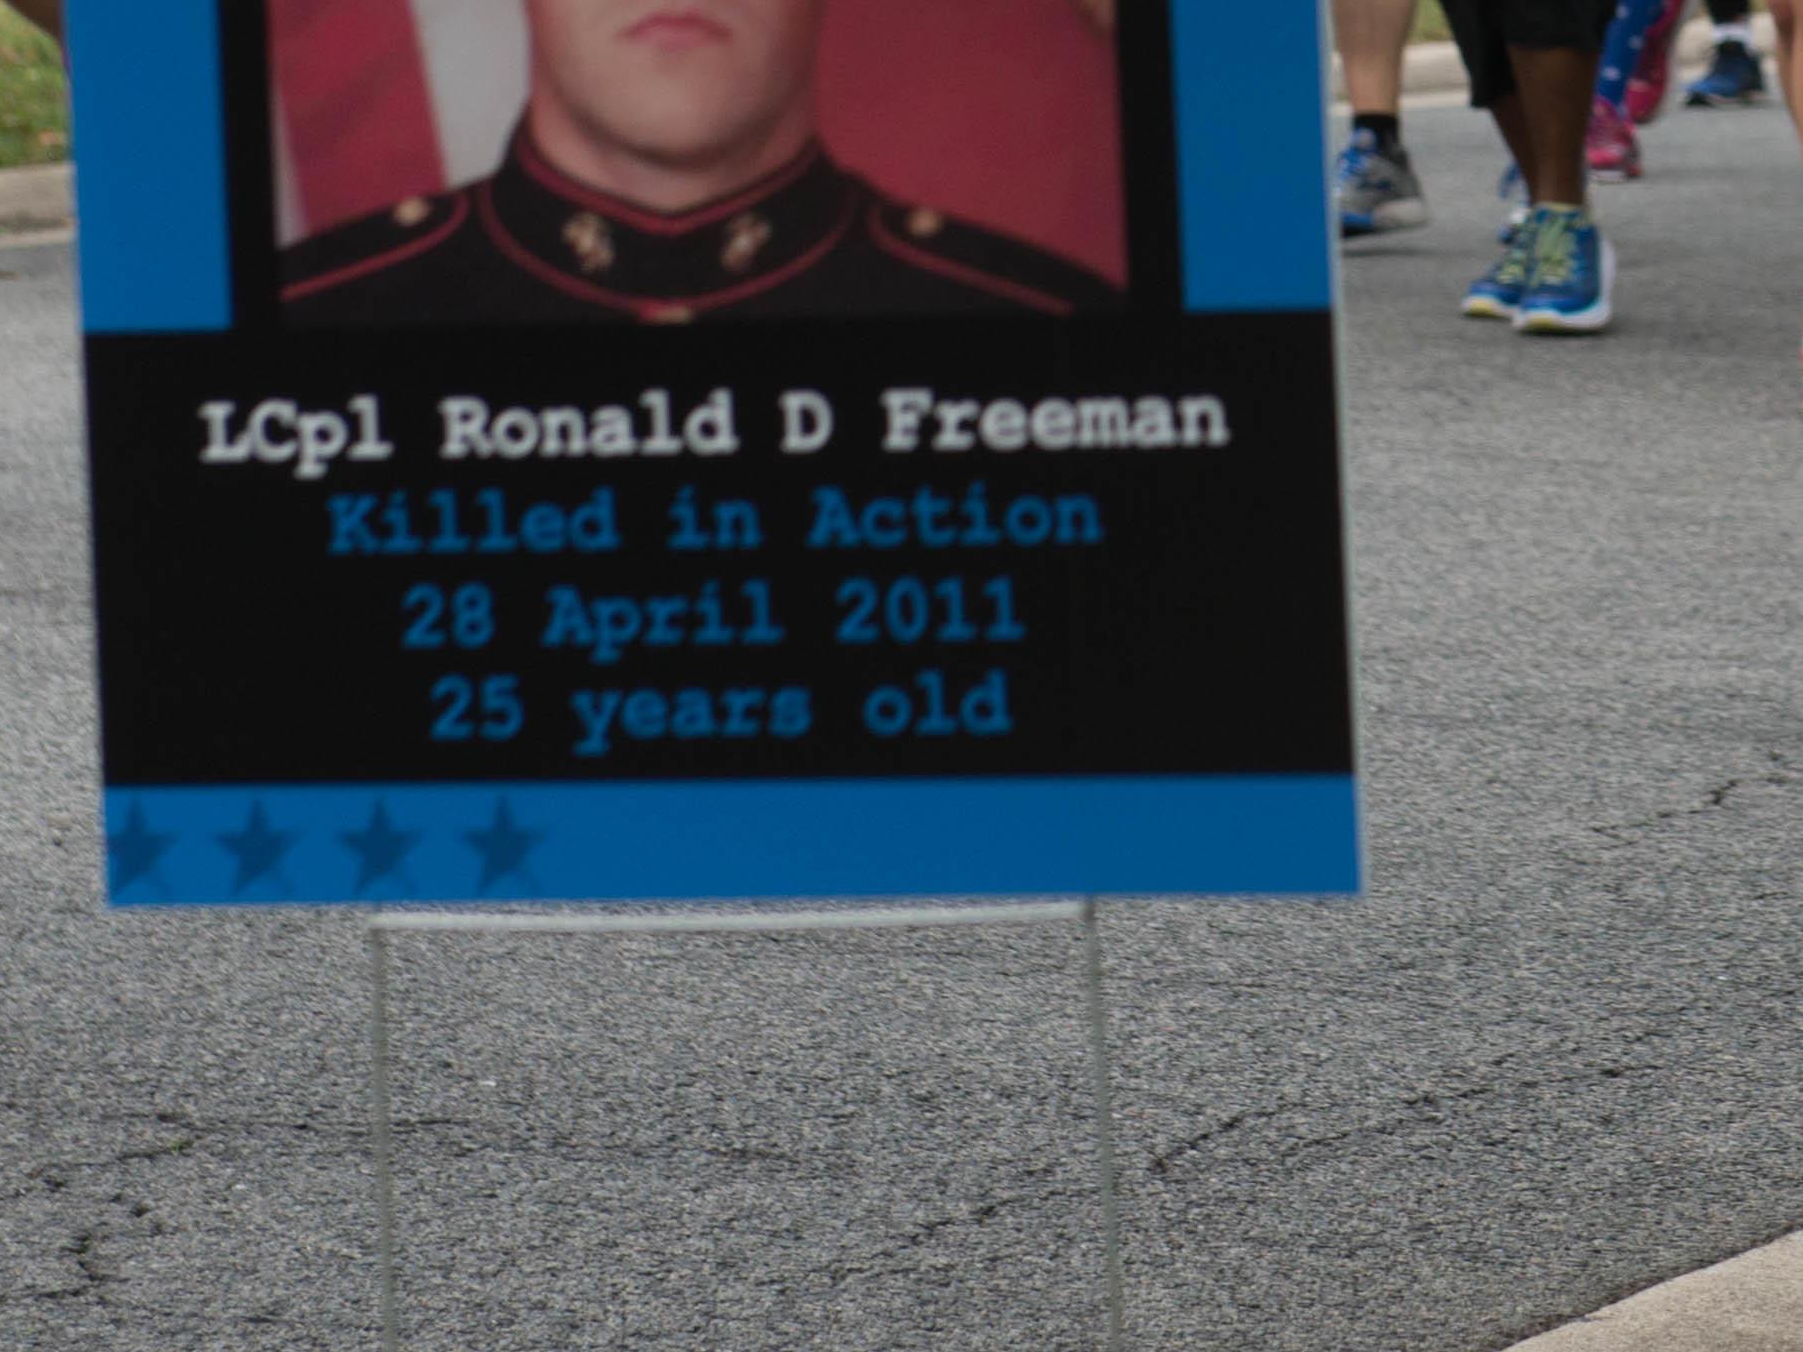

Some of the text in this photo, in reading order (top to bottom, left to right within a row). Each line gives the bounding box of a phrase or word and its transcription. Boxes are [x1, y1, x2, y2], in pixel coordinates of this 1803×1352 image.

[199, 388, 1231, 479] LCpl Ronald D Freeman
[328, 481, 1103, 556] Killed in Action
[402, 576, 1028, 662] 28 April 2011
[428, 669, 1015, 756] 25 years old
